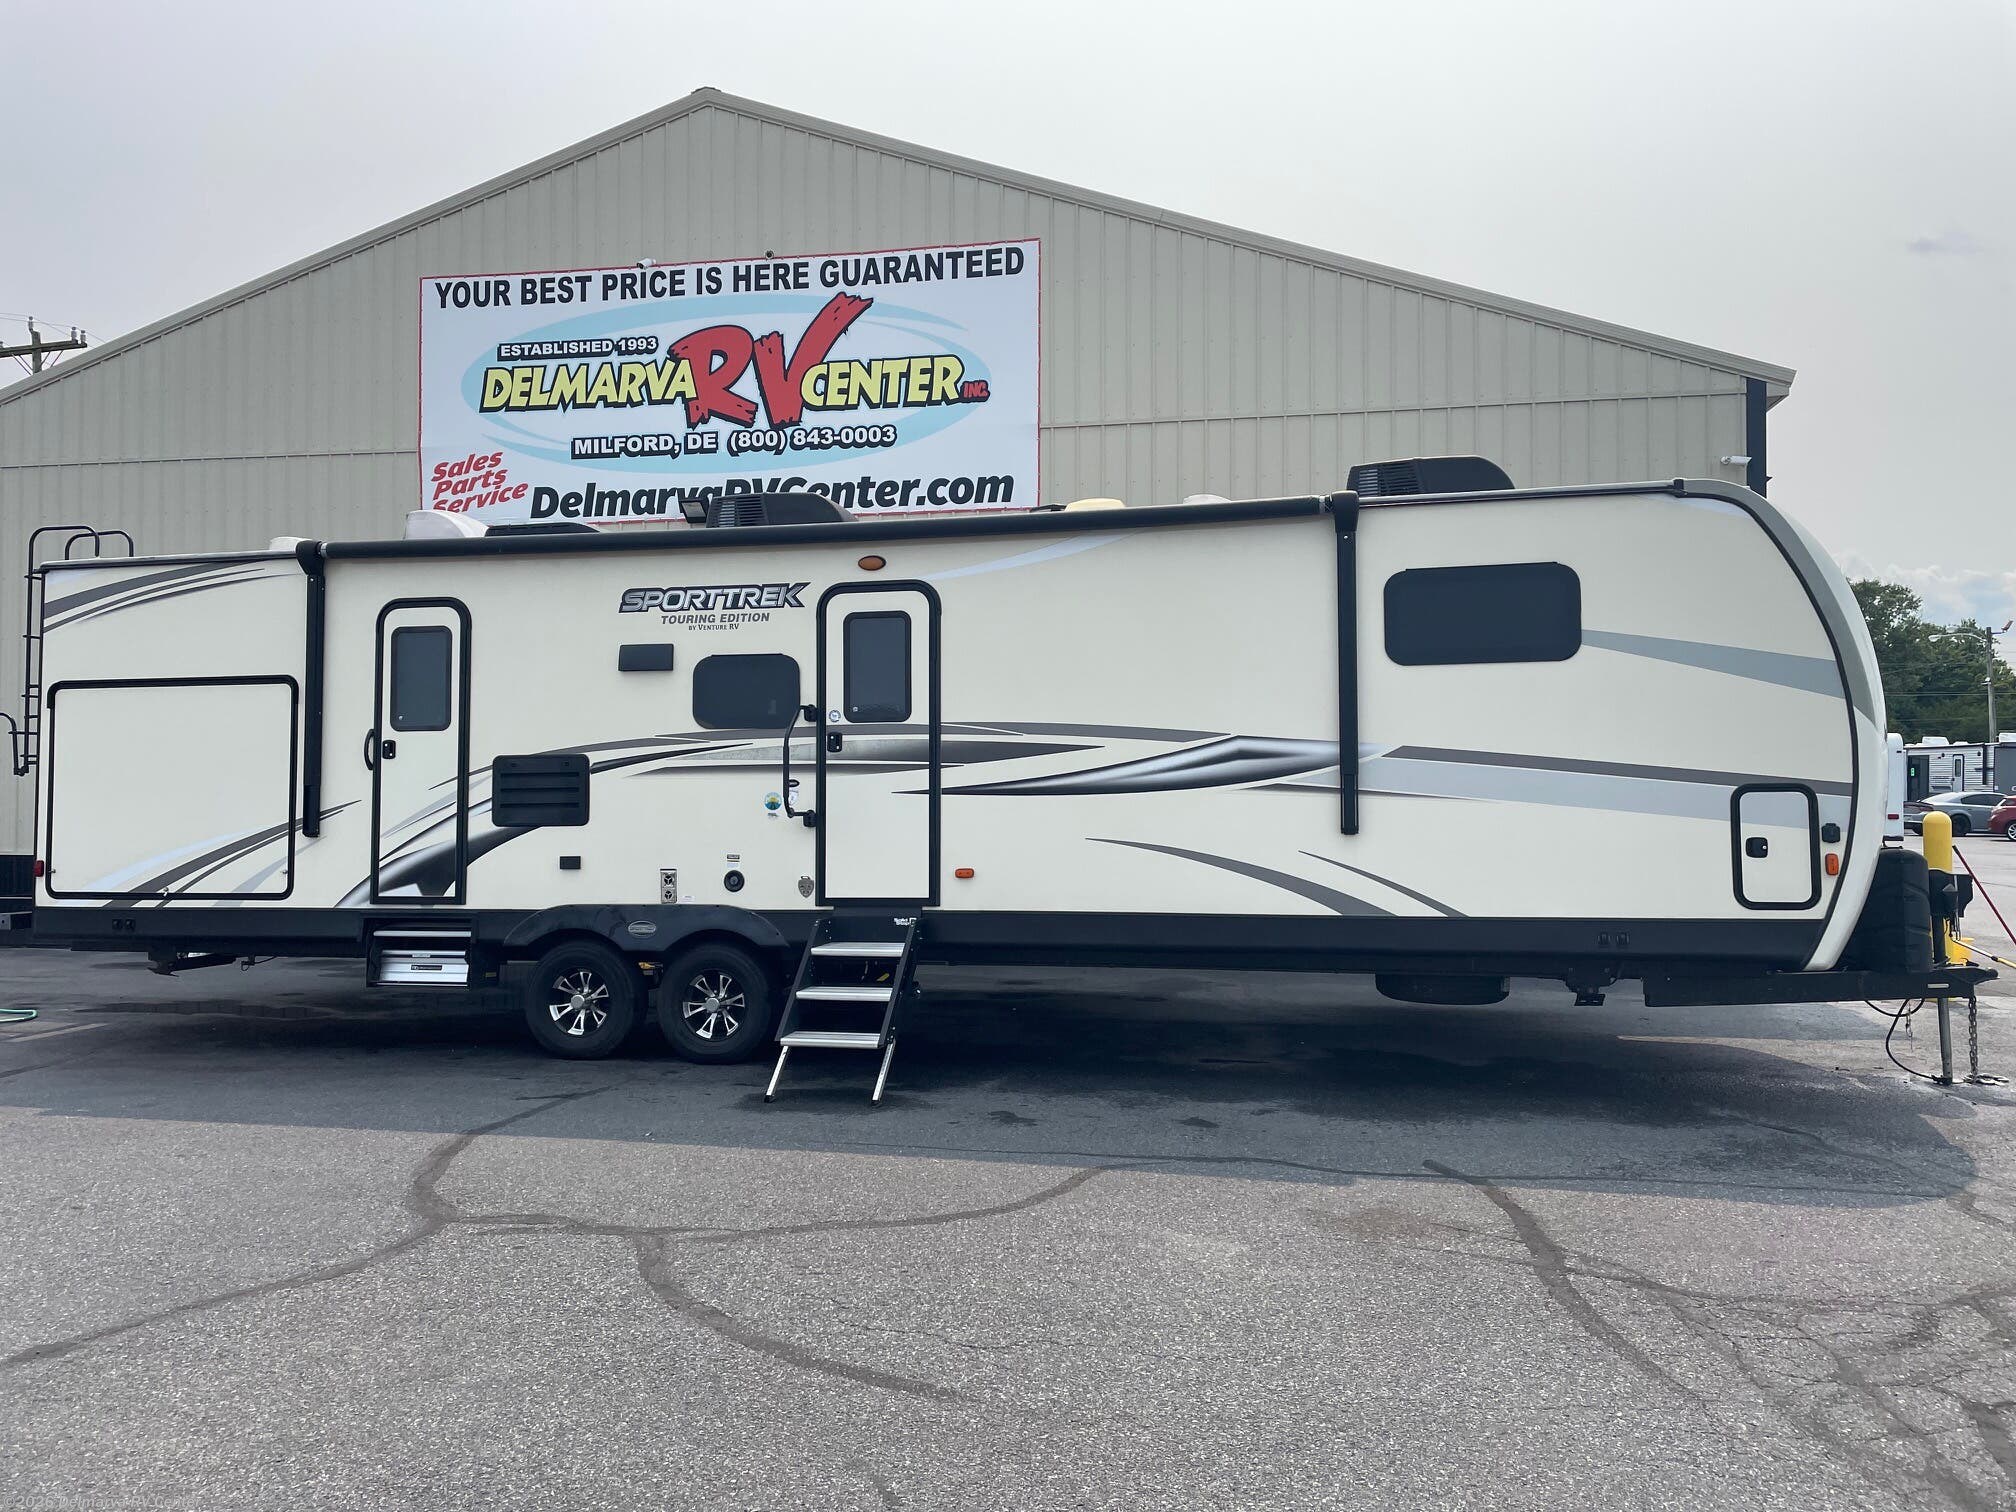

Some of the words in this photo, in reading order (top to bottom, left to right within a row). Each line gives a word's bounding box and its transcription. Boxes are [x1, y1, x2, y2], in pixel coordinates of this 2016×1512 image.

[434, 279, 511, 308] YOUR
[520, 275, 592, 305] BEST
[602, 269, 686, 300] PRICE
[696, 266, 722, 295] IS
[732, 261, 809, 292] HERE
[819, 246, 1024, 286] GUARANTEED
[480, 358, 697, 411] DELMARVA
[668, 291, 873, 429] RV
[799, 354, 964, 409] CENTER
[499, 339, 614, 358] ESTABLISHED
[616, 336, 658, 352] 1993
[573, 435, 681, 456] MILFORD,
[686, 432, 717, 451] DE
[729, 430, 787, 452] (800)
[792, 425, 897, 447] 843-0003
[431, 452, 503, 481] Sales
[433, 469, 508, 500] Parts
[619, 582, 811, 613] SPORTTREK
[661, 614, 716, 624] TOURING
[719, 612, 770, 623] EDITION
